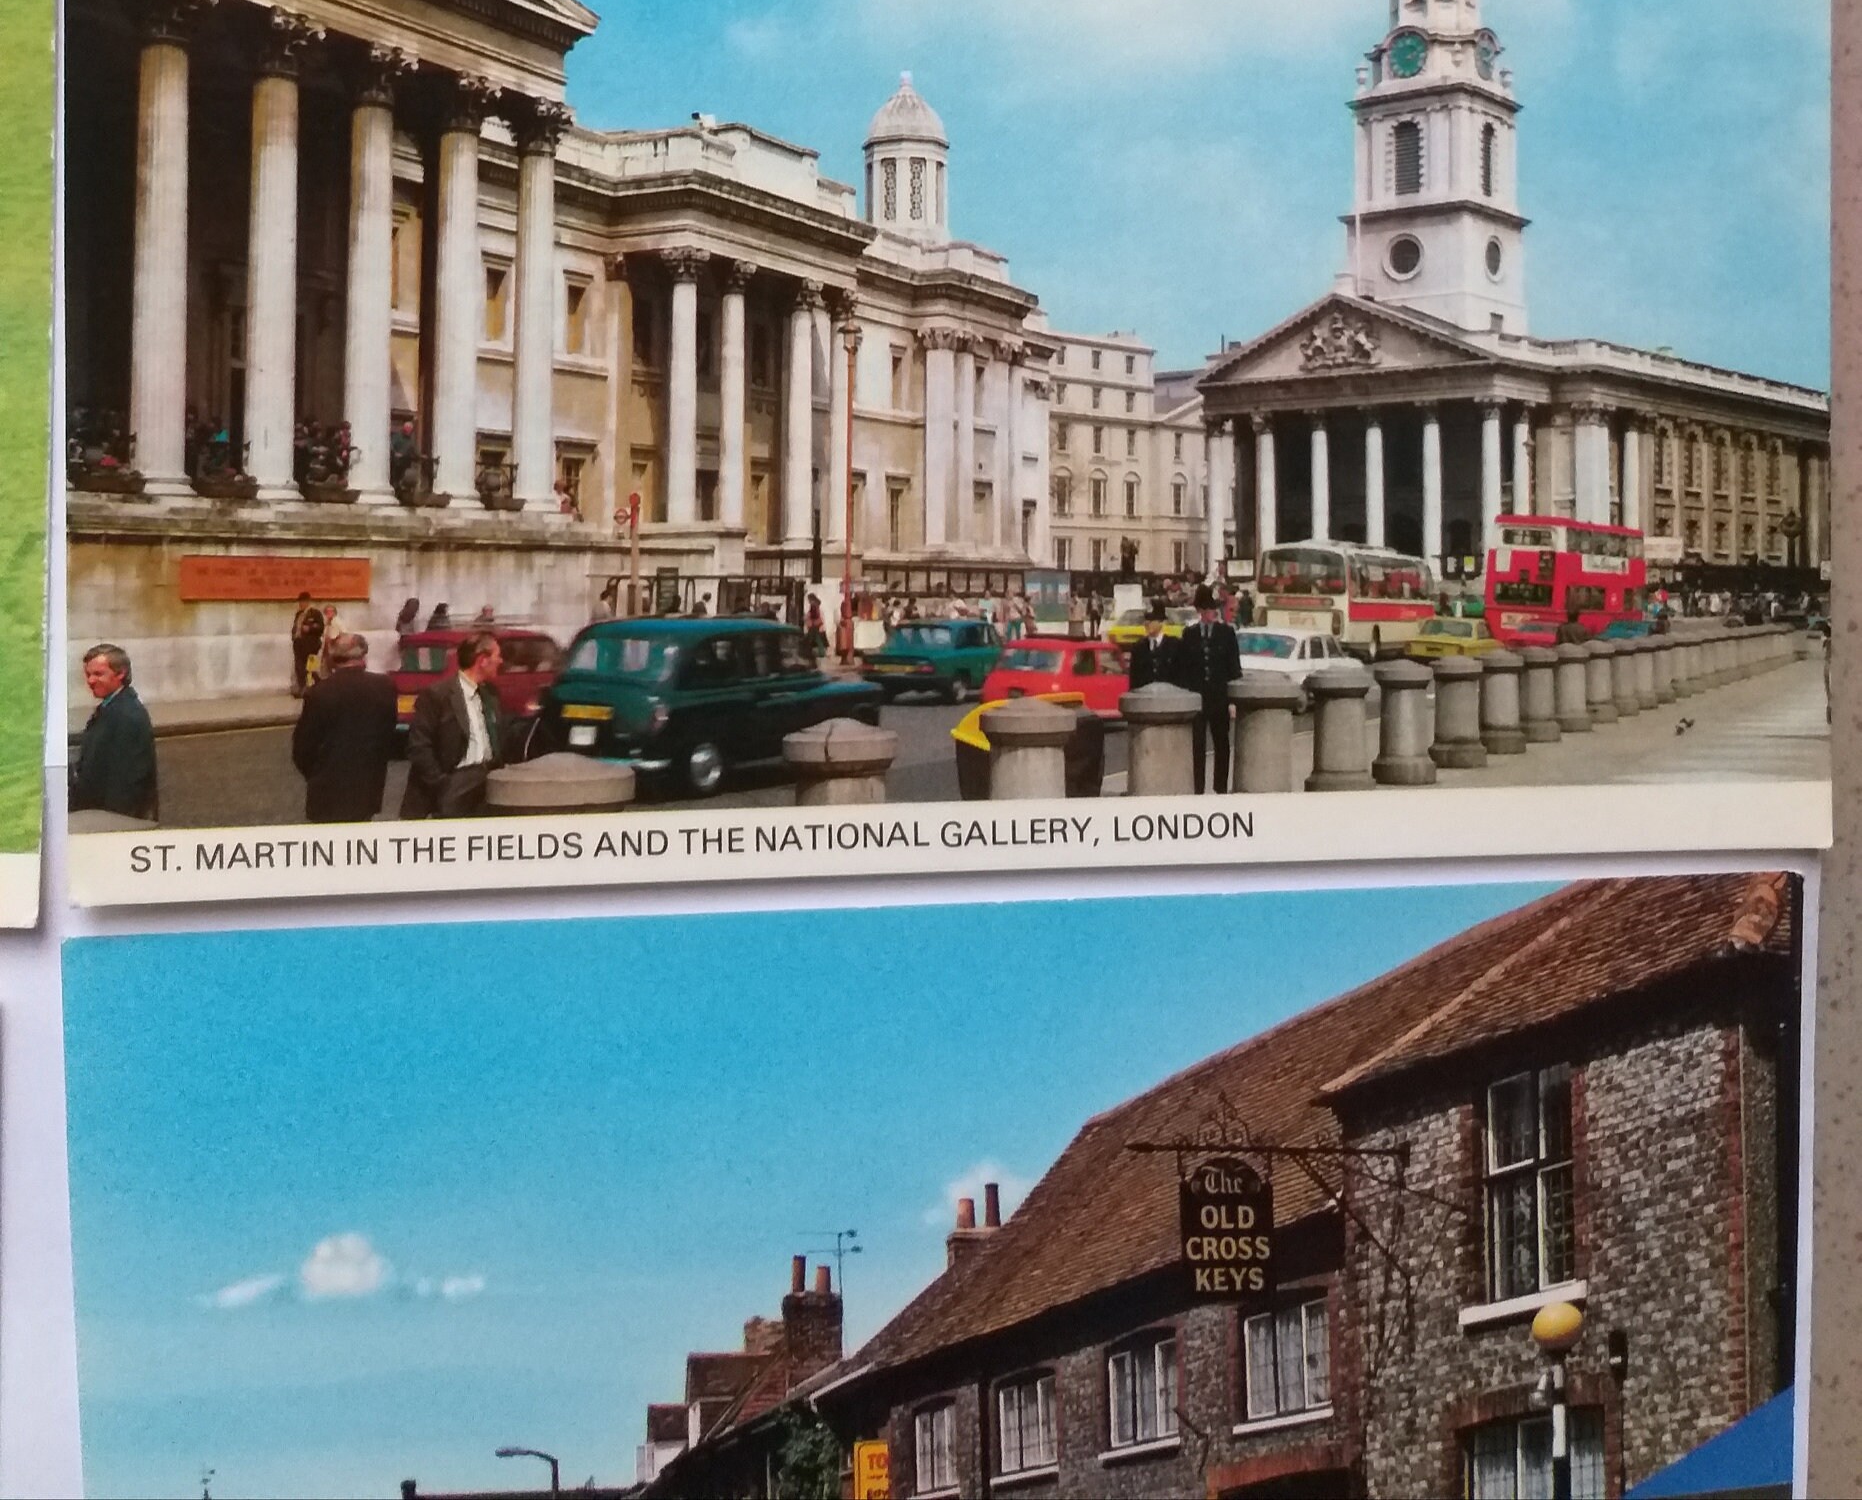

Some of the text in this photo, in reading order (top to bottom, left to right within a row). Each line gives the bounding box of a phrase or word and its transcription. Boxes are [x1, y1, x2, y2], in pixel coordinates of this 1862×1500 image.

[130, 811, 1255, 874] ST. MARTIN IN THE FIELDS AND THE NATIONAL GALLERY, LONDON
[1201, 1165, 1243, 1194] The
[1200, 1204, 1255, 1230] OLD
[1186, 1236, 1271, 1261] CROSS
[1195, 1267, 1265, 1292] KEYS
